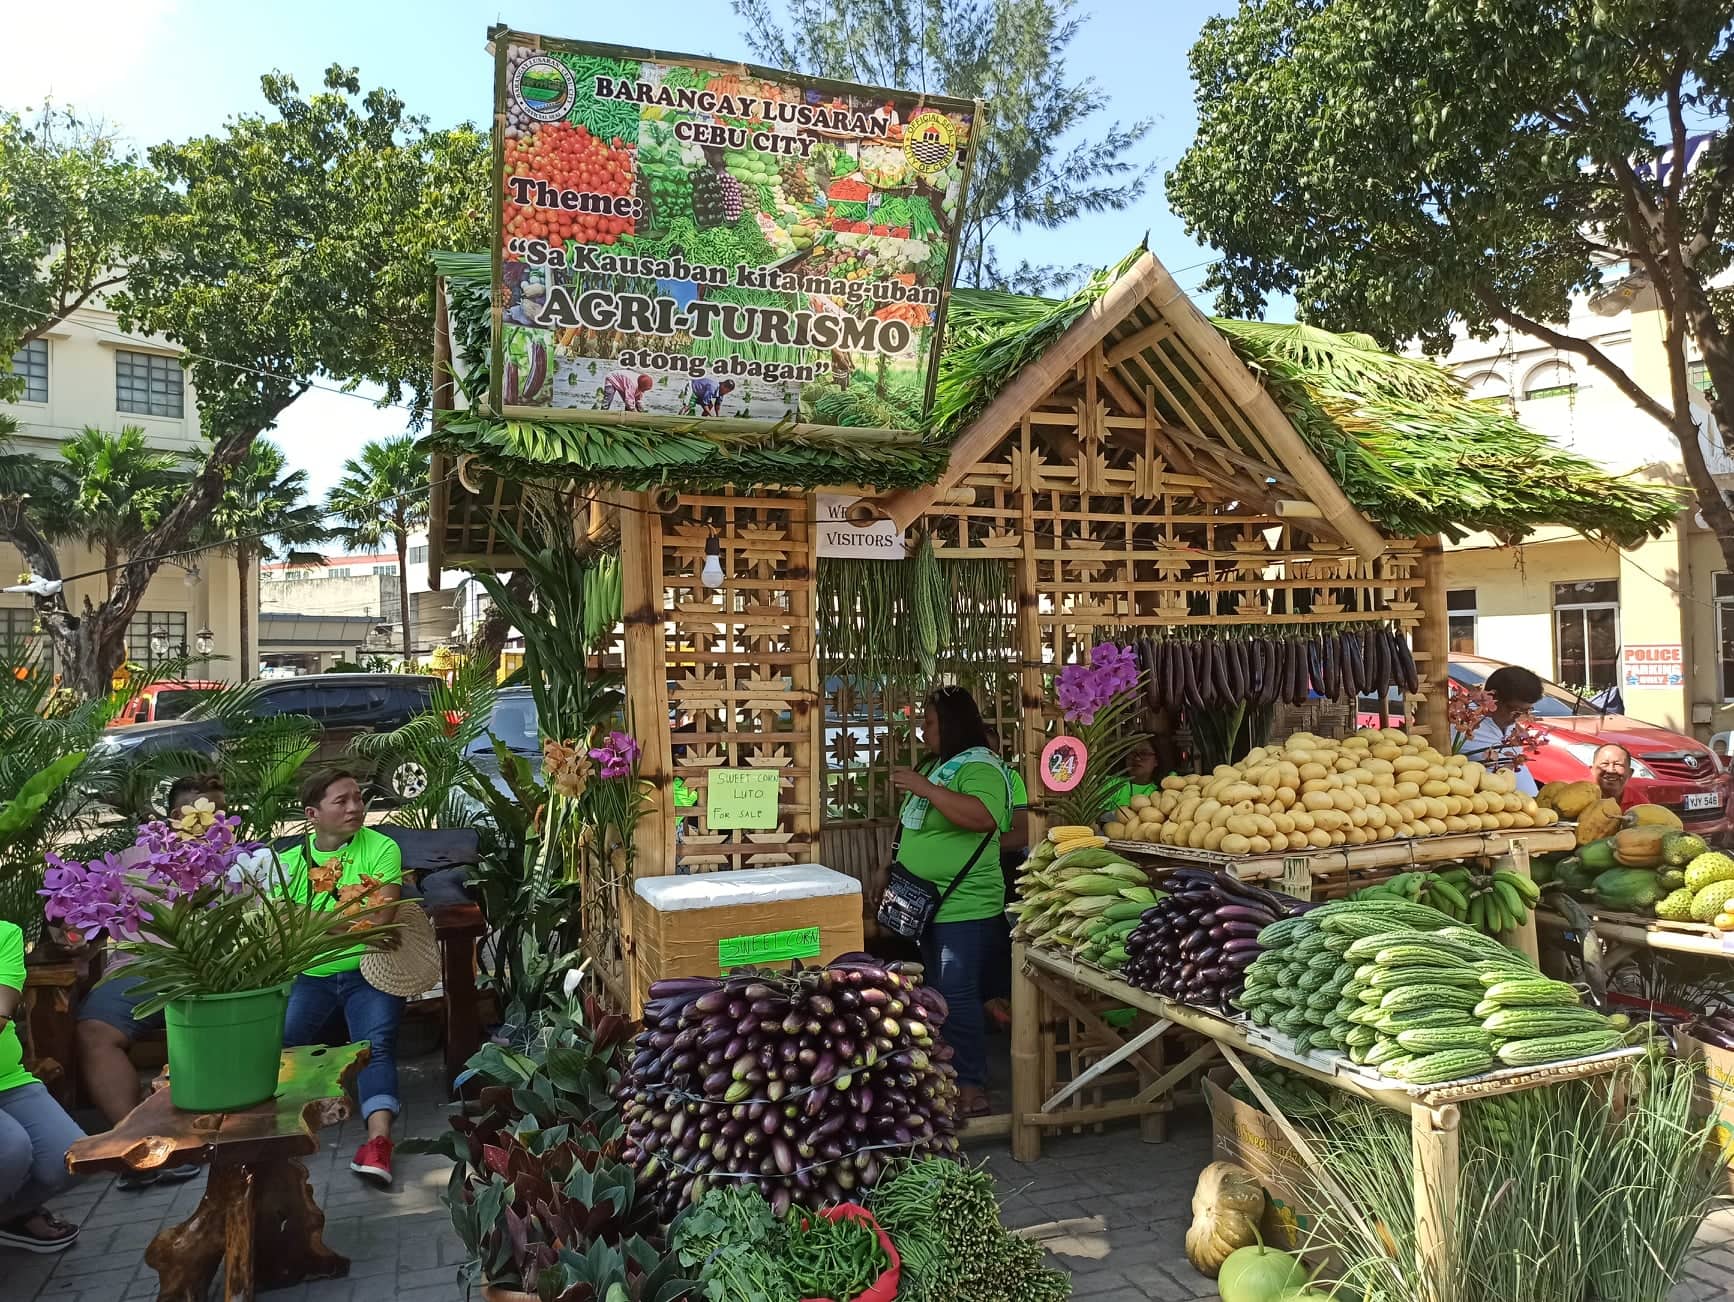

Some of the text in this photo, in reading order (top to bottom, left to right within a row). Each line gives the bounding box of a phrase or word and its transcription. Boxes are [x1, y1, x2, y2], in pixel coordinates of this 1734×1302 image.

[595, 77, 889, 137] BARANGAY LUSARAN
[908, 114, 955, 138] OFFICIAL SEAL
[674, 121, 817, 158] CEBU CITY
[905, 145, 954, 173] CITY OF CEBU
[510, 177, 643, 218] Theme:
[509, 239, 938, 304] “Sa Kausaban kita mag-uban
[537, 288, 910, 353] AGRI-TURISMO
[619, 349, 830, 382] atong abagan”
[827, 531, 893, 547] VISITORS
[1624, 649, 1681, 661] POLICE
[1051, 754, 1075, 774] 24
[717, 772, 752, 785] SWEET
[734, 788, 764, 800] LUTO
[739, 809, 762, 818] SALE
[727, 930, 819, 956] SWEET CORN
